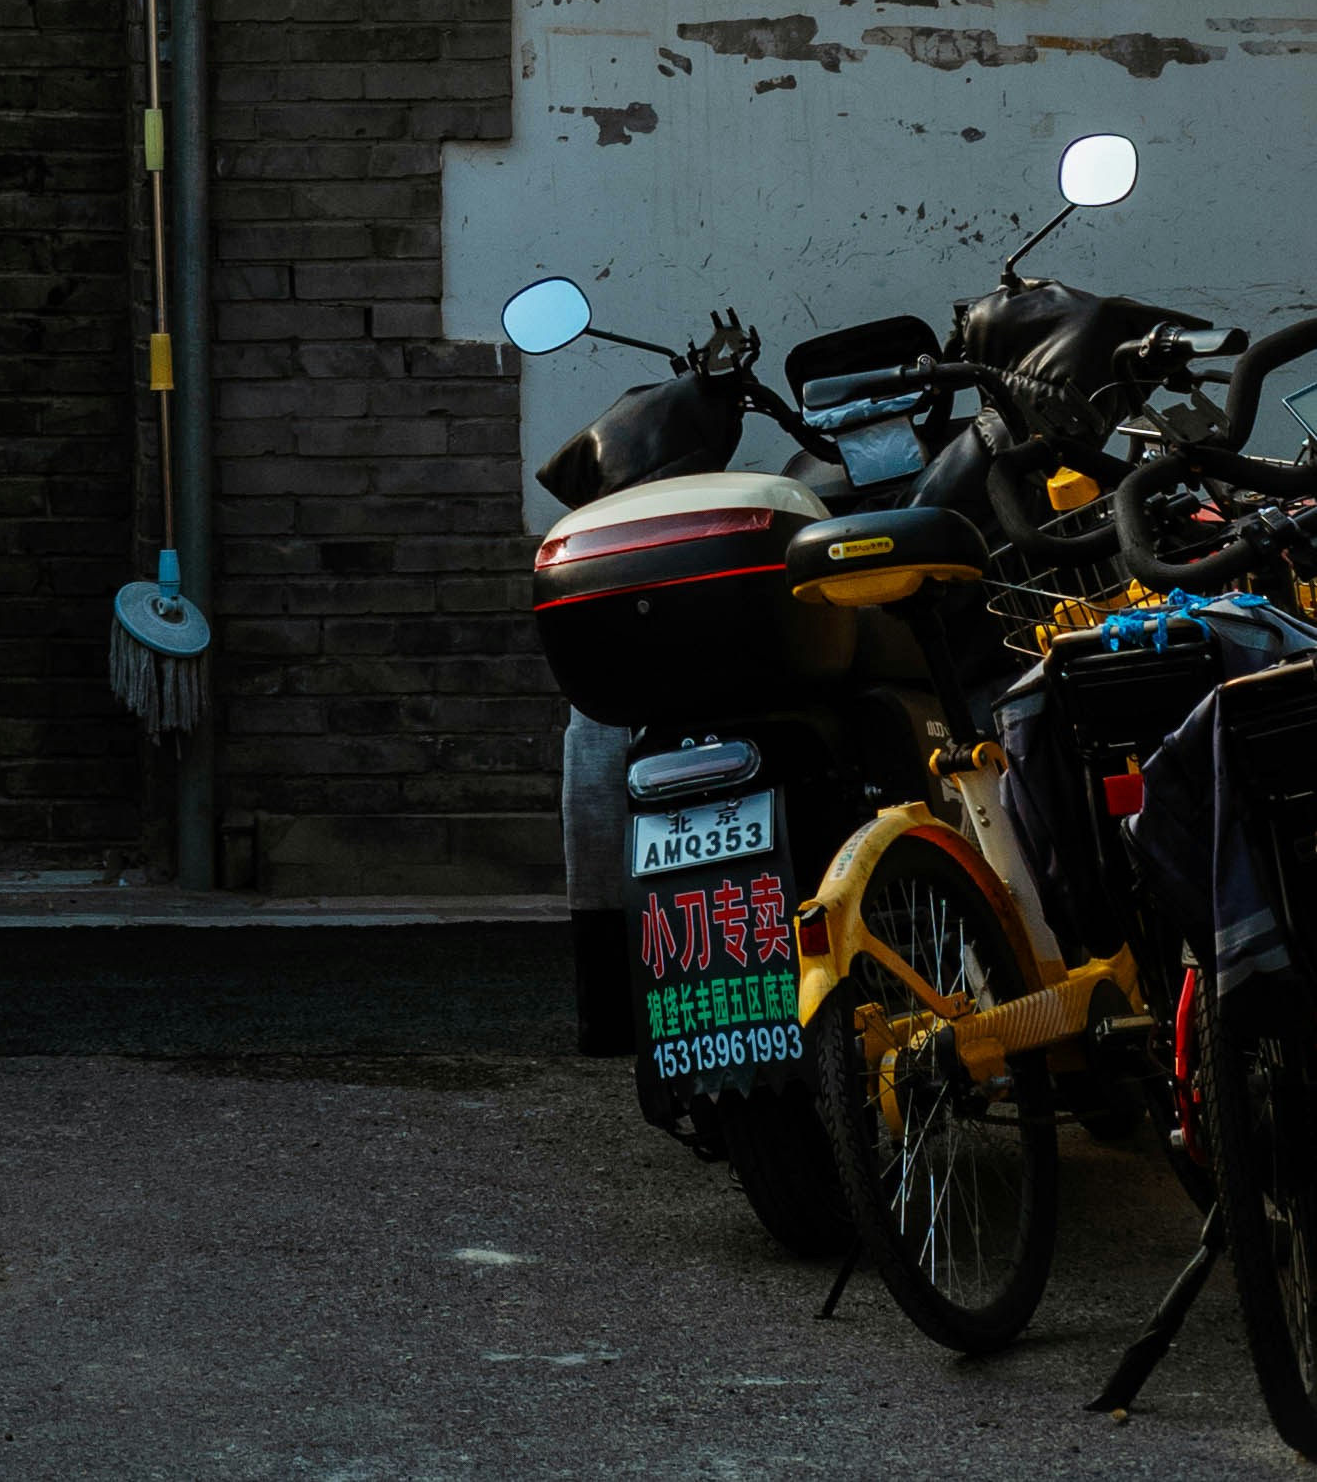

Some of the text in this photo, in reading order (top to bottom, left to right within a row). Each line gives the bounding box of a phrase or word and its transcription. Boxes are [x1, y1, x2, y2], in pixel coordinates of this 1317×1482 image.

[644, 822, 763, 869] AMQ353
[668, 807, 740, 835] 北京
[641, 872, 791, 980] 小刀专卖
[646, 968, 799, 1041] 狼垡长丰园五区底商
[653, 1023, 804, 1080] 15313961993
